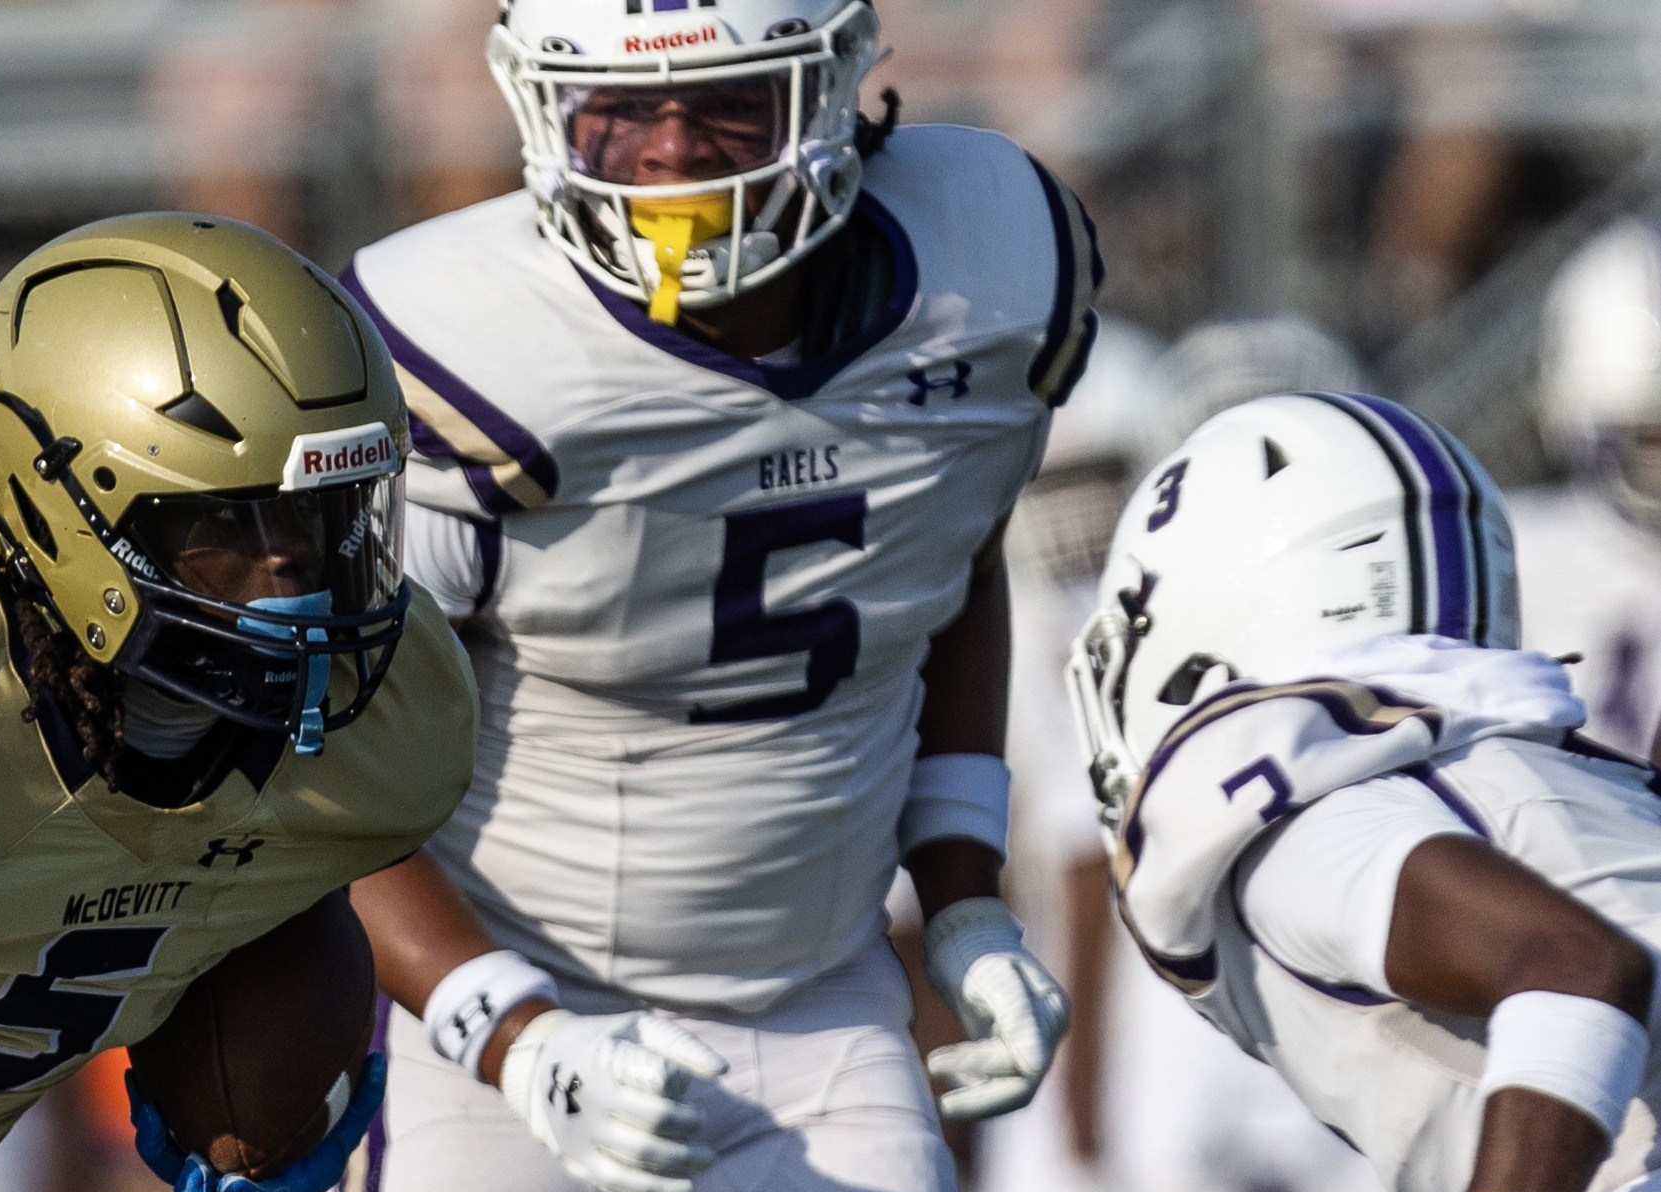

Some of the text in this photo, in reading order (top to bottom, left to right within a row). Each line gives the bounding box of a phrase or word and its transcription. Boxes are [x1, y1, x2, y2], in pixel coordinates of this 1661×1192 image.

[624, 25, 717, 53] Riddell
[303, 436, 392, 475] Riddell
[758, 444, 839, 490] GAELS
[1146, 457, 1191, 533] 3
[685, 488, 868, 725] 5
[62, 881, 192, 926] McDEVITT
